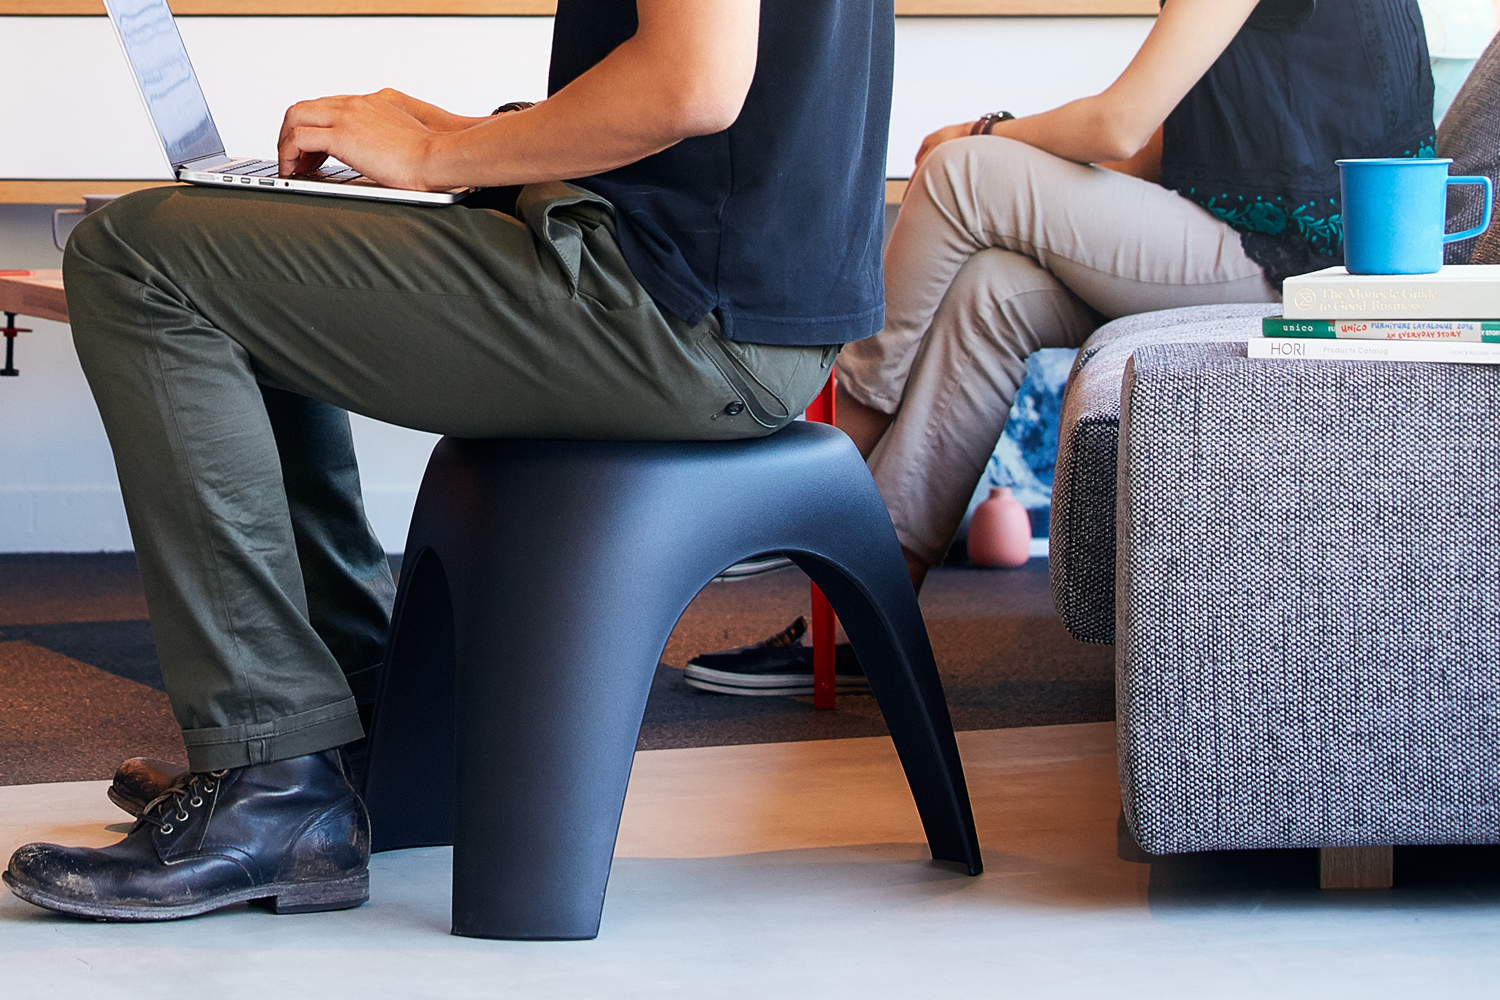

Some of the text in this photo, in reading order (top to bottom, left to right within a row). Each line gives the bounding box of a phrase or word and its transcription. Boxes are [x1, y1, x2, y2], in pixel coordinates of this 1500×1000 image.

[1320, 287, 1438, 300] The Monocle Guide
[1319, 300, 1422, 312] to Good Business
[1282, 323, 1314, 332] unico
[1412, 322, 1453, 331] CATALOGUE
[1398, 331, 1435, 339] EVERYDAY
[1270, 342, 1389, 356] HORI Products Catalog
